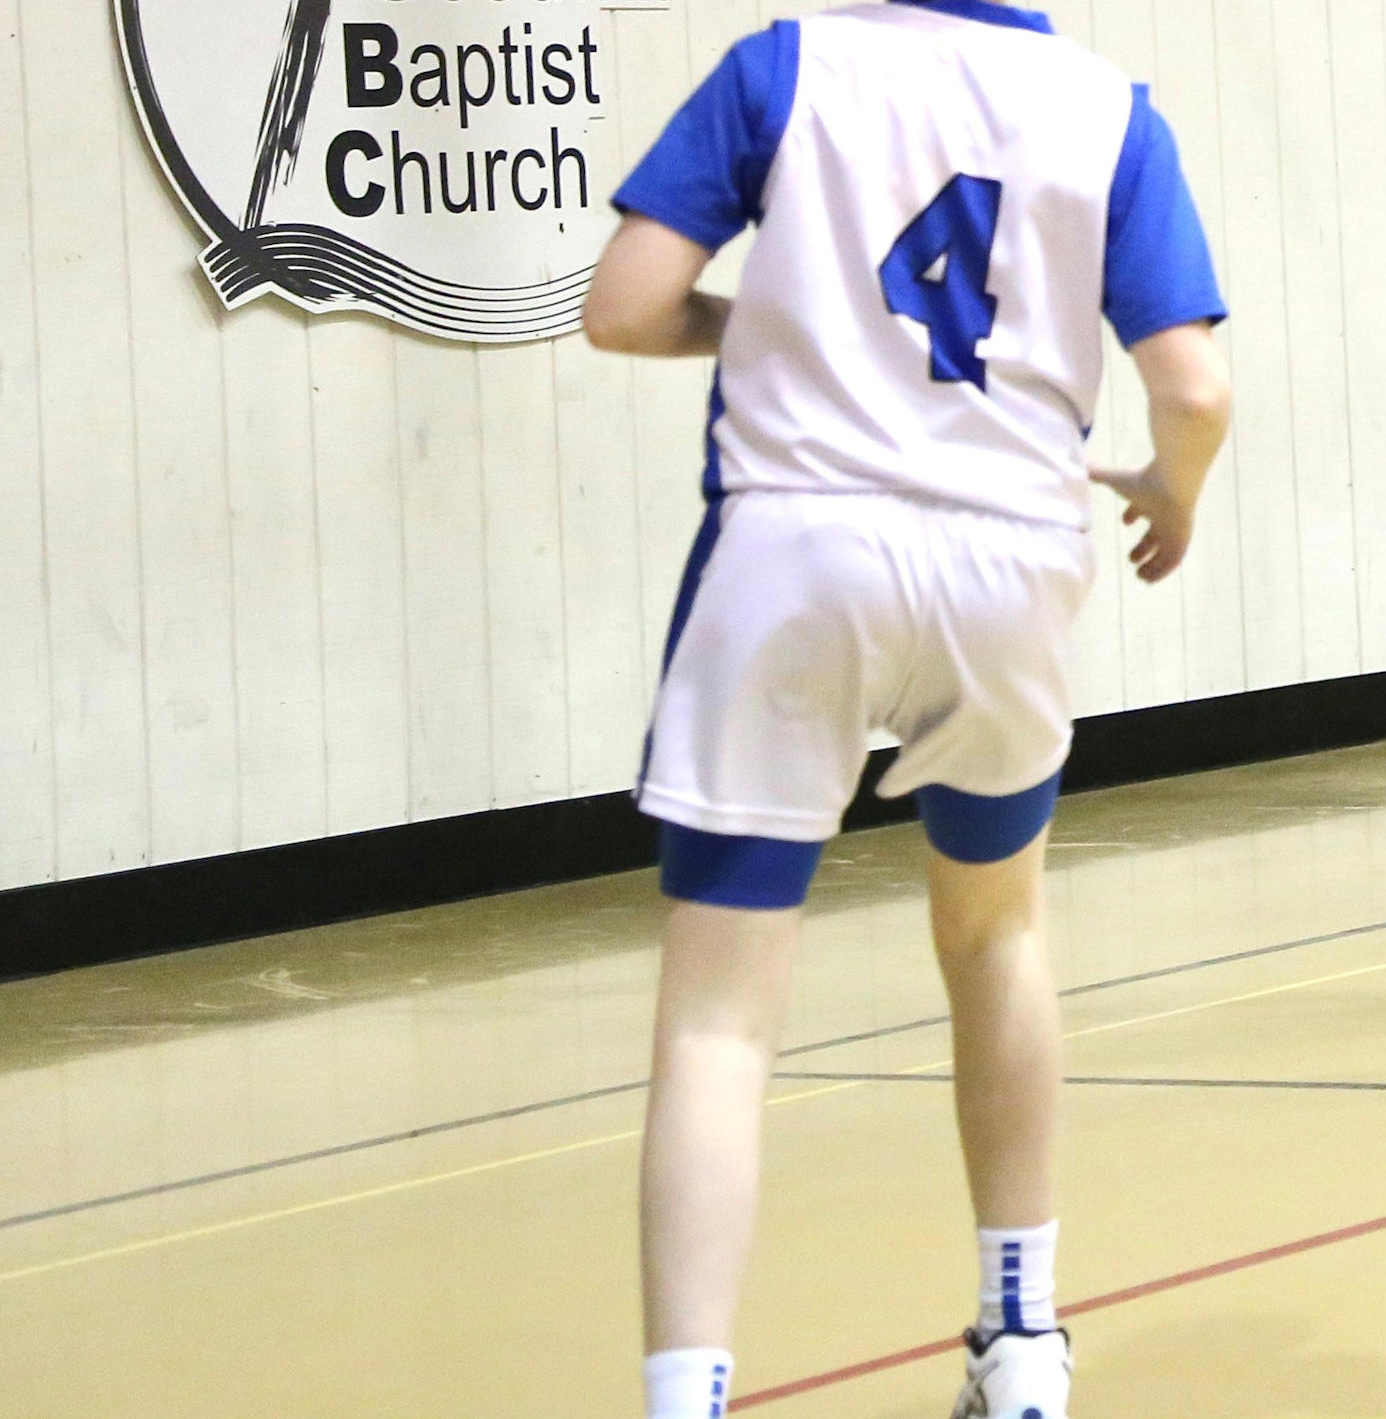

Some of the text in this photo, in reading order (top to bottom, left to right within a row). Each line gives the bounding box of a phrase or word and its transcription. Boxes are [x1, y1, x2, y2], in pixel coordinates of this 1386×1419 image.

[342, 22, 601, 128] Baptist
[325, 127, 588, 217] Church
[878, 173, 1003, 392] 4
